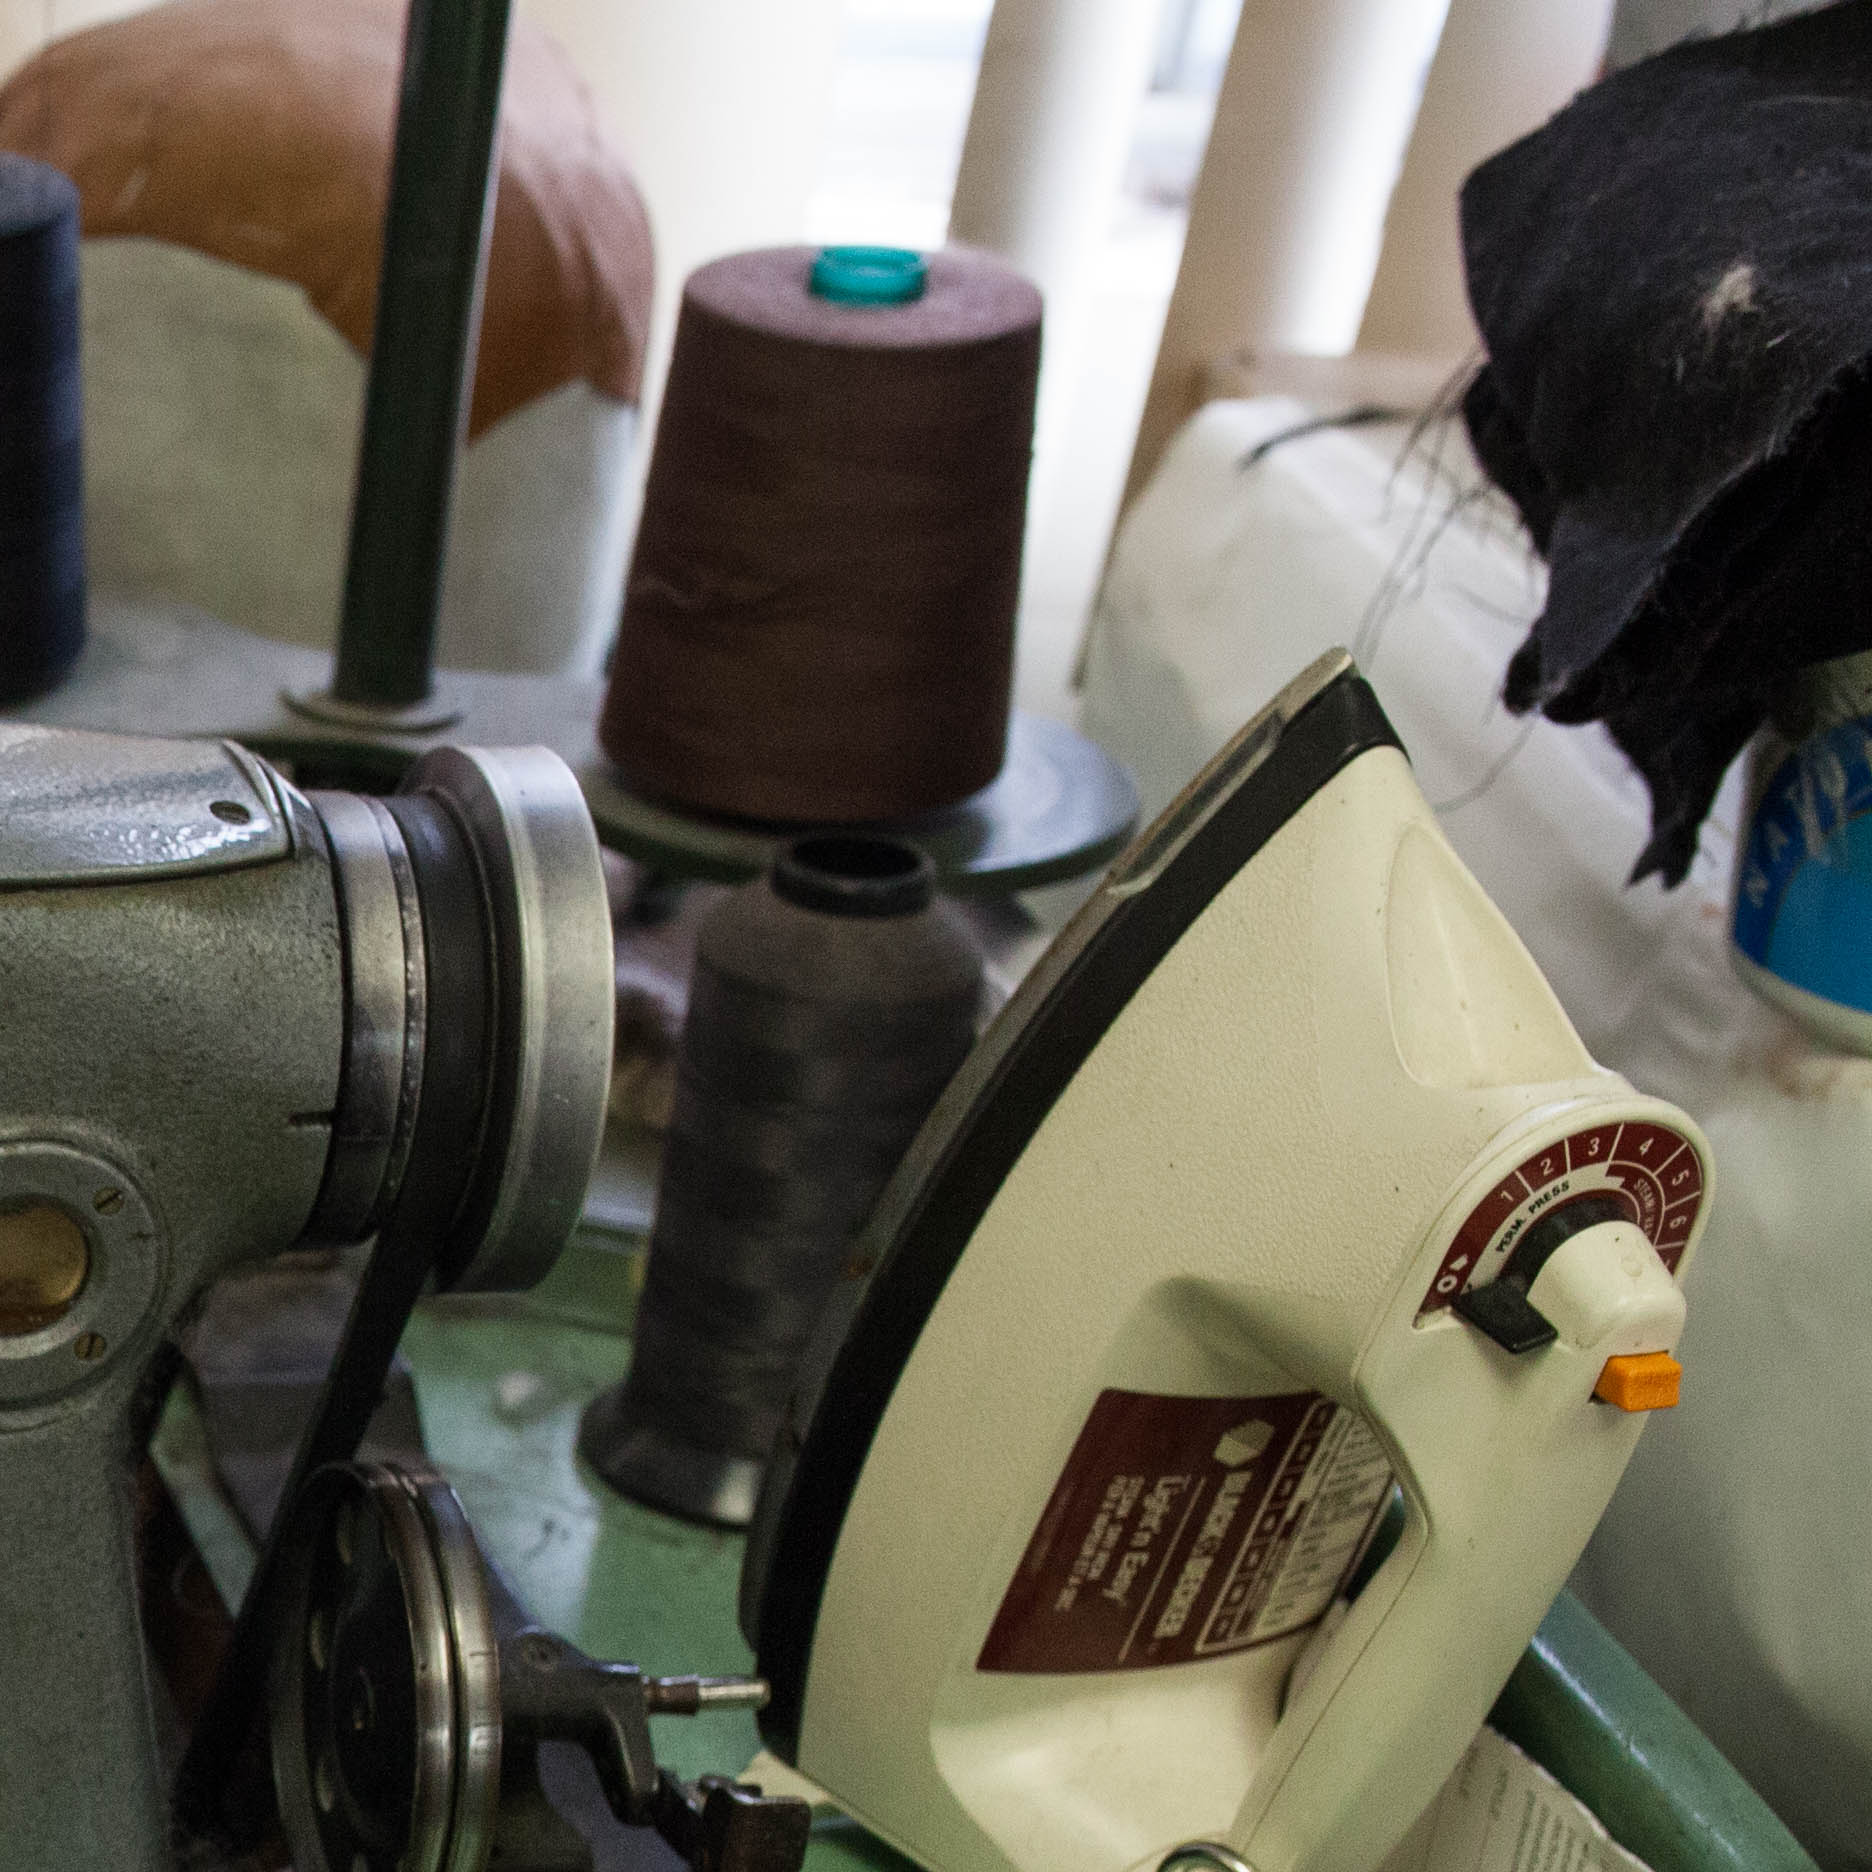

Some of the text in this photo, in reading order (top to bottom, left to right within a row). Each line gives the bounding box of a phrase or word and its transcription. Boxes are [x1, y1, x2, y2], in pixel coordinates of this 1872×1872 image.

[1588, 1138, 1600, 1156] 3
[1640, 1138, 1654, 1155] 4
[1541, 1159, 1554, 1176] 2
[1672, 1169, 1689, 1186] 5
[1501, 1190, 1513, 1202] 1
[1529, 1181, 1570, 1213] PRESS
[1670, 1215, 1687, 1229] 6
